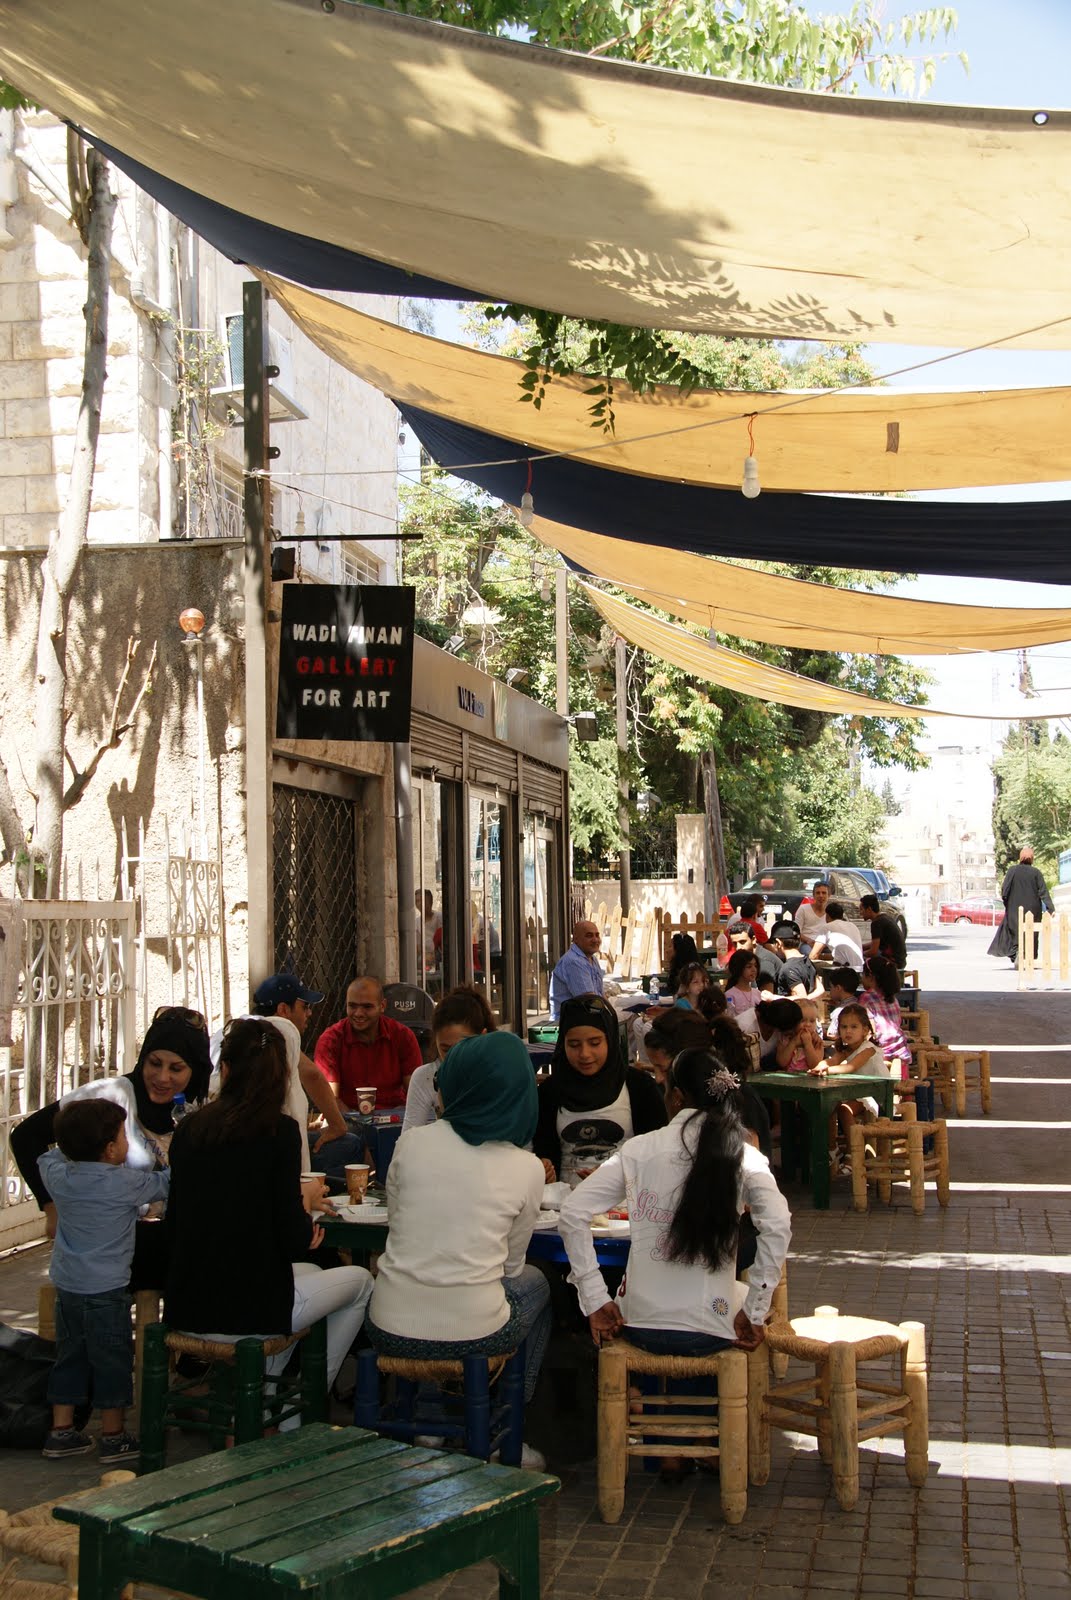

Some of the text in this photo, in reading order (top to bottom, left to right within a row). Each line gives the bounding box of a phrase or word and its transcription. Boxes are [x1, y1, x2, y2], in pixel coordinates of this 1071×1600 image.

[293, 624, 336, 642] WADI
[296, 656, 398, 677] GALLERY
[302, 688, 391, 708] FOR ART
[394, 1000, 416, 1008] PUSH
